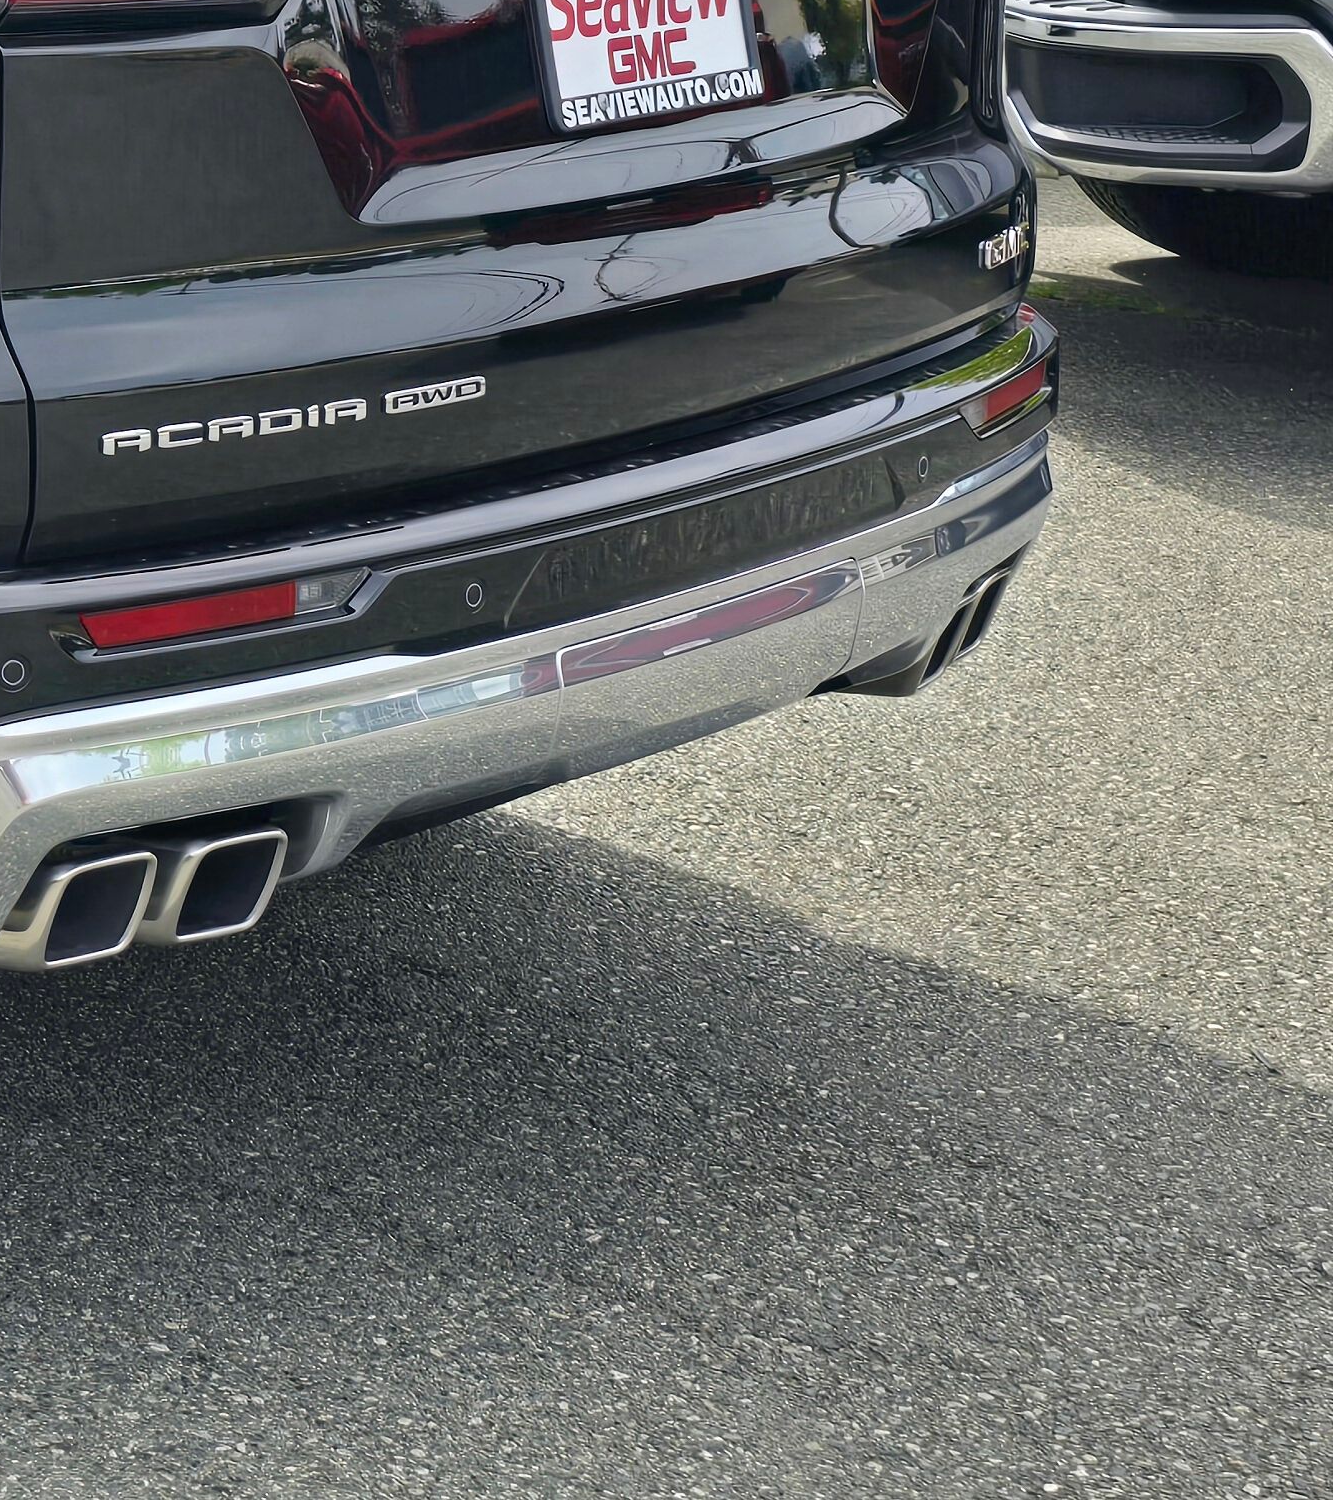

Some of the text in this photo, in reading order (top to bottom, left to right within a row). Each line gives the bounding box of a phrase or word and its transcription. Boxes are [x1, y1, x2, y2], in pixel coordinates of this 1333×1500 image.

[606, 29, 696, 85] GMC
[562, 68, 763, 129] SEAVIEWAUTO.COM
[100, 380, 481, 456] ACADIA AWD
